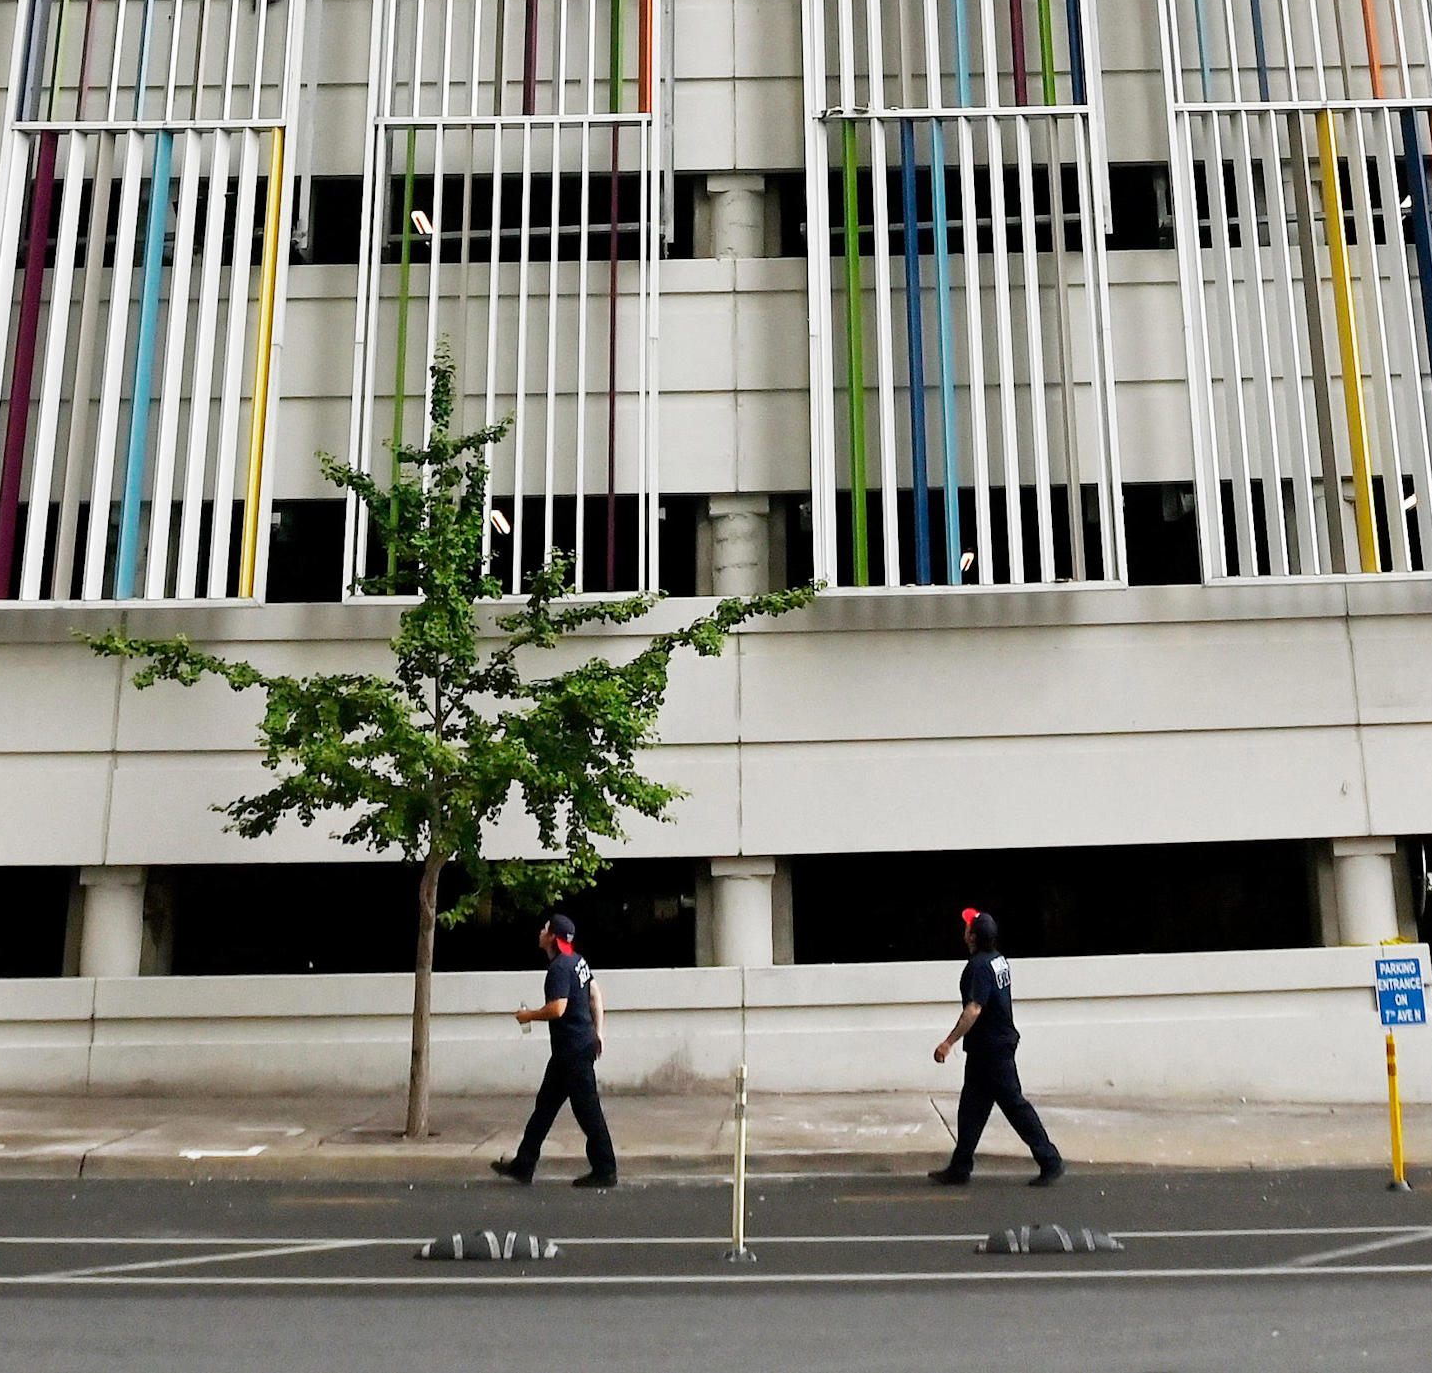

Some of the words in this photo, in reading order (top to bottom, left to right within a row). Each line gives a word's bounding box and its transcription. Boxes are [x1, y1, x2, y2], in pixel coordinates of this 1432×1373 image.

[1379, 961, 1416, 975] PARKING
[1377, 977, 1422, 991] ENTRANCE
[1395, 993, 1408, 1006] ON
[1397, 1009, 1413, 1022] AVE
[1414, 1009, 1421, 1021] N
